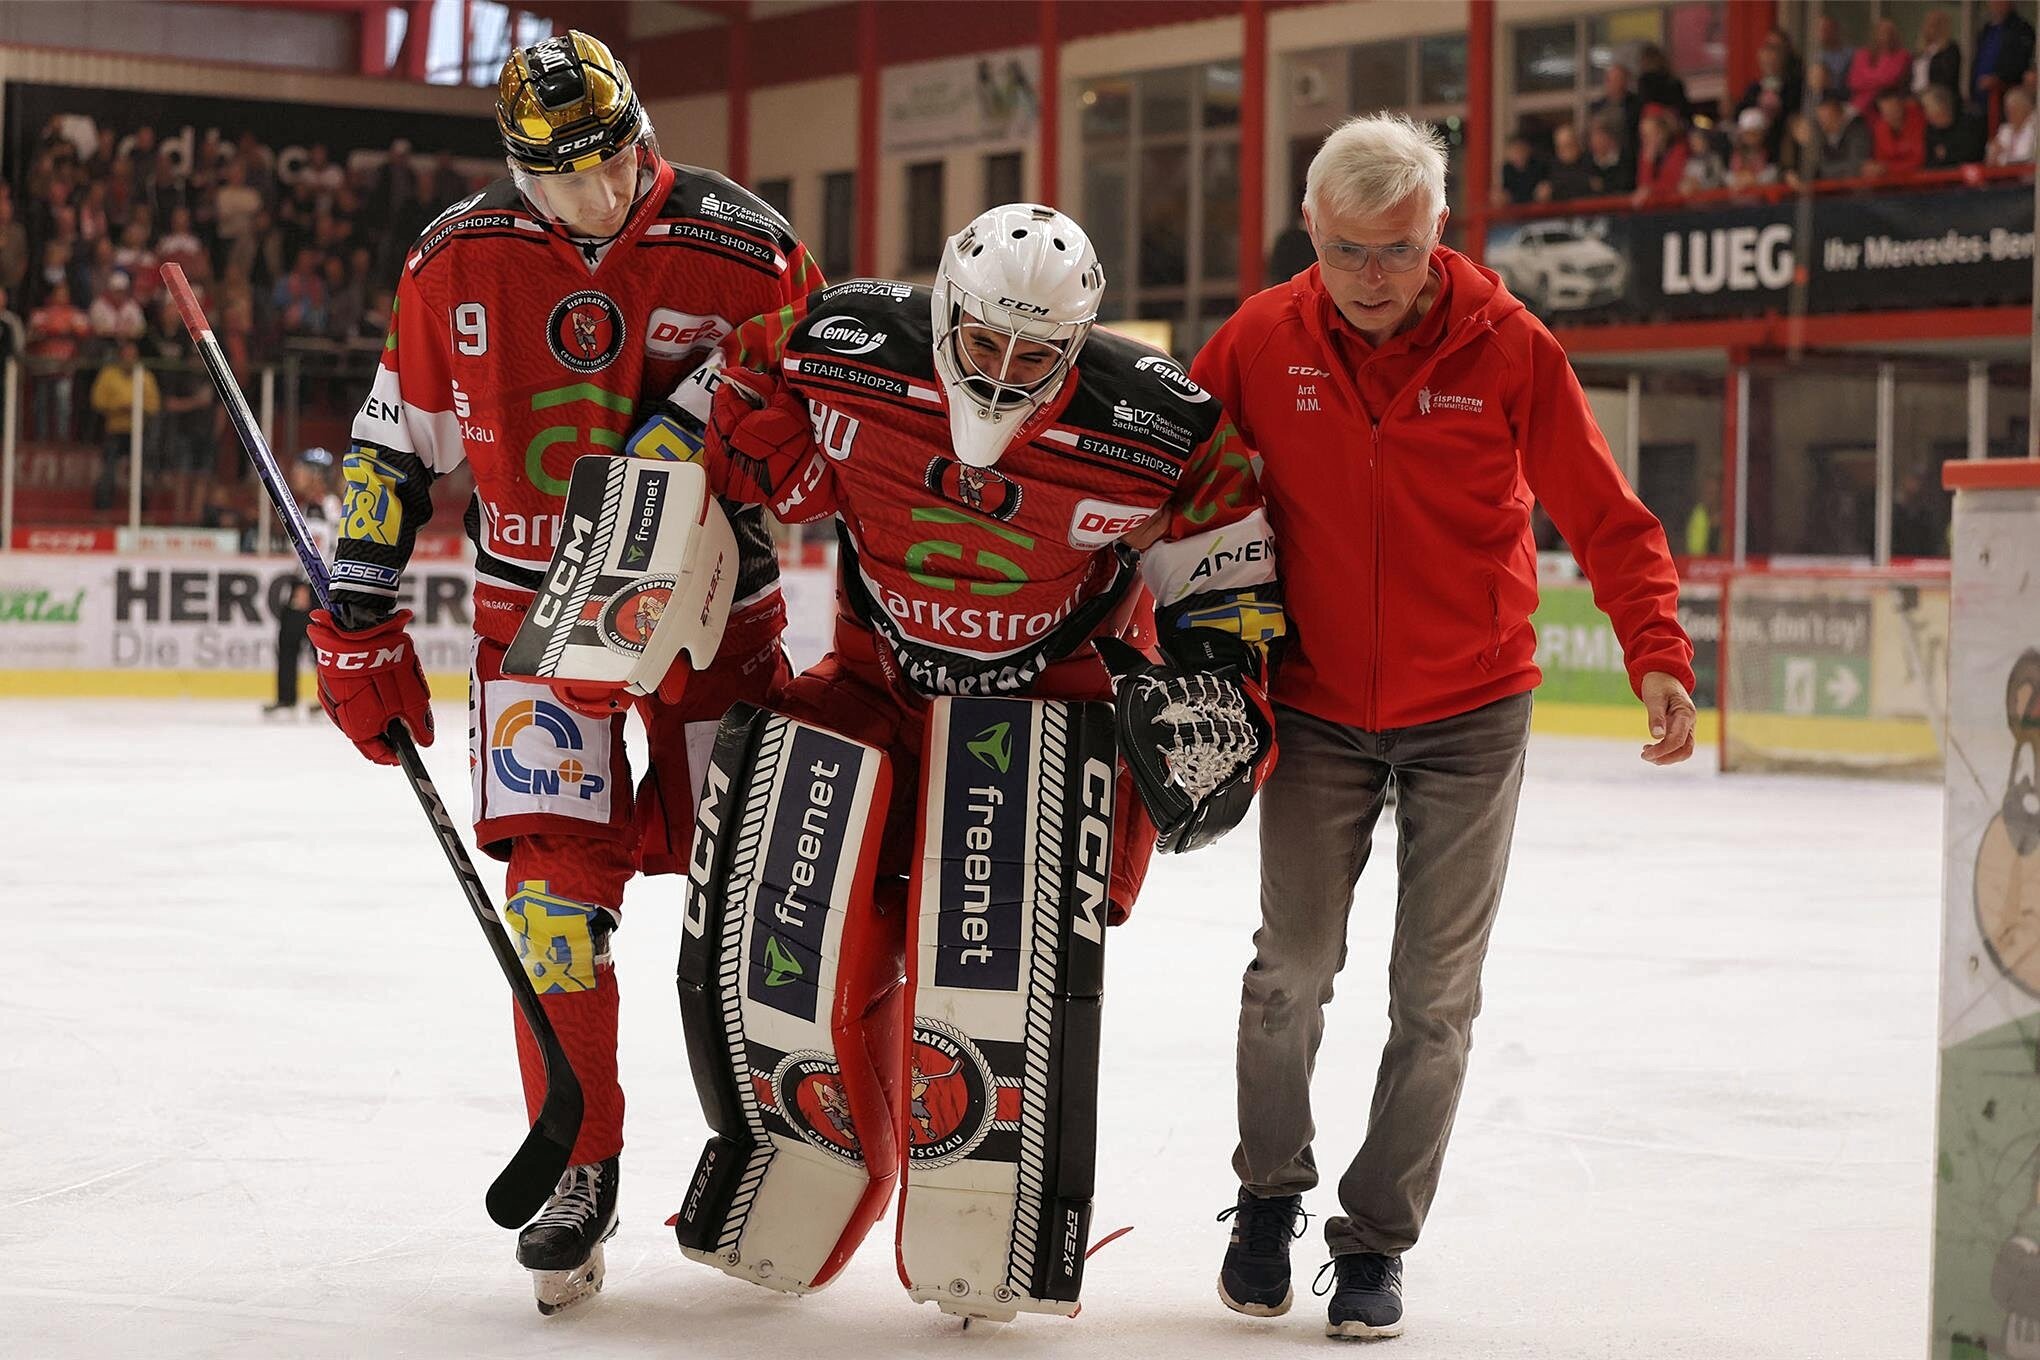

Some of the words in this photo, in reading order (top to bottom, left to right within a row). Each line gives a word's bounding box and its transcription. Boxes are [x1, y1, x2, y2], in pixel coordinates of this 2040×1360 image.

[558, 131, 604, 154] CCM
[700, 208, 733, 222] Sachsen
[424, 216, 509, 253] STAHL-SHOP24
[674, 225, 770, 261] STAHL-SHOP24
[1824, 238, 1861, 271] Ihr
[1864, 228, 2034, 270] Mercedes-Ben
[1662, 224, 1795, 294] LUEG
[566, 297, 610, 311] EISPIRATEN
[998, 296, 1050, 316] CCM
[448, 302, 487, 356] 9
[560, 350, 611, 368] CRIMMITSCHAU
[1287, 366, 1330, 378] CCM
[804, 362, 903, 394] STAHL-SHOP24
[1298, 384, 1317, 396] Arzt
[1296, 399, 1322, 412] M.M.
[1432, 403, 1484, 414] CRIMMITSCHAU
[1433, 395, 1484, 407] EISPIRATEN
[809, 398, 860, 461] 90
[1111, 418, 1150, 436] Sachsen
[1151, 420, 1191, 447] Versicherung
[1082, 439, 1177, 478] STAHL-SHOP24
[635, 478, 660, 542] freenet
[533, 514, 594, 629] CCM
[317, 644, 405, 670] CCM
[684, 760, 731, 940] CCM
[774, 758, 841, 929] freenet
[1073, 756, 1111, 945] CCM
[960, 785, 1004, 966] freenet
